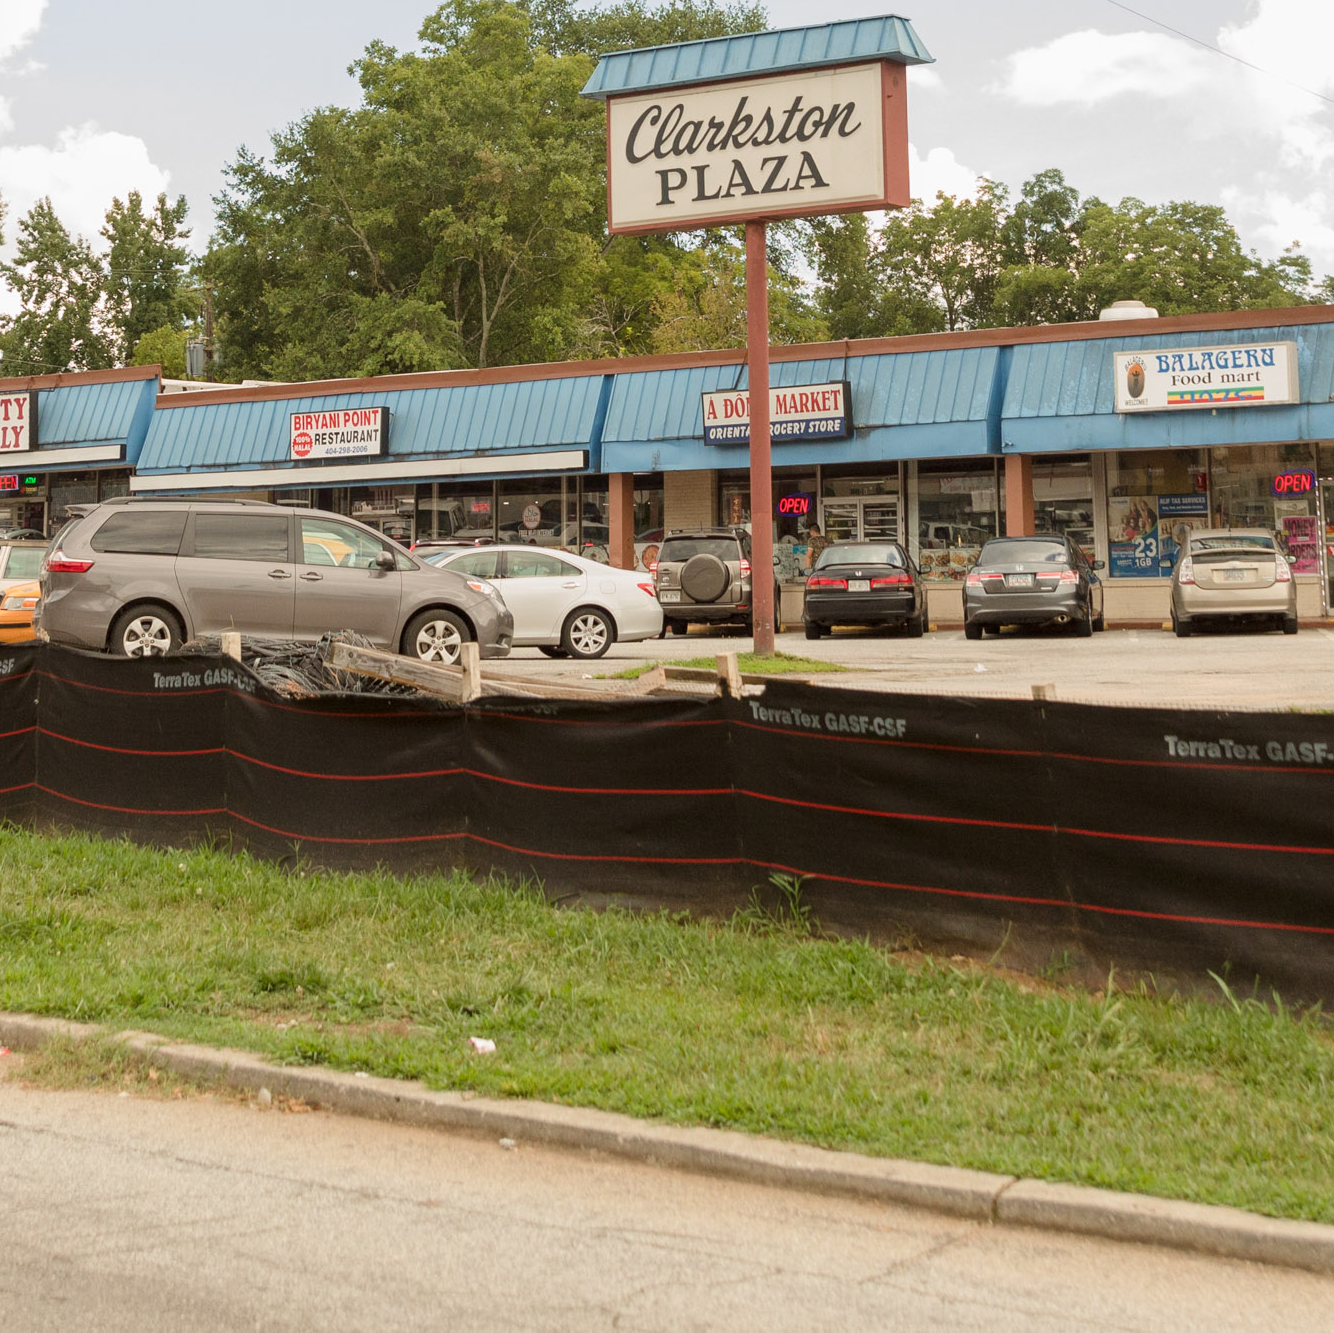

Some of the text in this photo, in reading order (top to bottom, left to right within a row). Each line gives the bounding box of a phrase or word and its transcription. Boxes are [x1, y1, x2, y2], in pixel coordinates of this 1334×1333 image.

[625, 96, 861, 164] Clarkston
[655, 151, 829, 206] PLAZA
[1155, 348, 1275, 373] BALAGERU
[1171, 370, 1261, 386] Food mart
[775, 389, 840, 415] MARKET
[294, 409, 379, 431] BIRYANI POINT
[709, 419, 841, 440] ORIENTA ROCERY STORE
[314, 429, 379, 446] RESTAURANT
[325, 445, 368, 455] 404-298-2006
[24, 476, 36, 484] ATM
[1275, 474, 1311, 493] OPEN
[779, 497, 809, 514] OPEN
[1182, 496, 1206, 504] SERVICES
[1135, 557, 1152, 567] 1GB
[153, 672, 202, 689] TerraTex
[749, 700, 907, 738] TerraTex GASF-CSF
[1164, 734, 1261, 761] TerraTex
